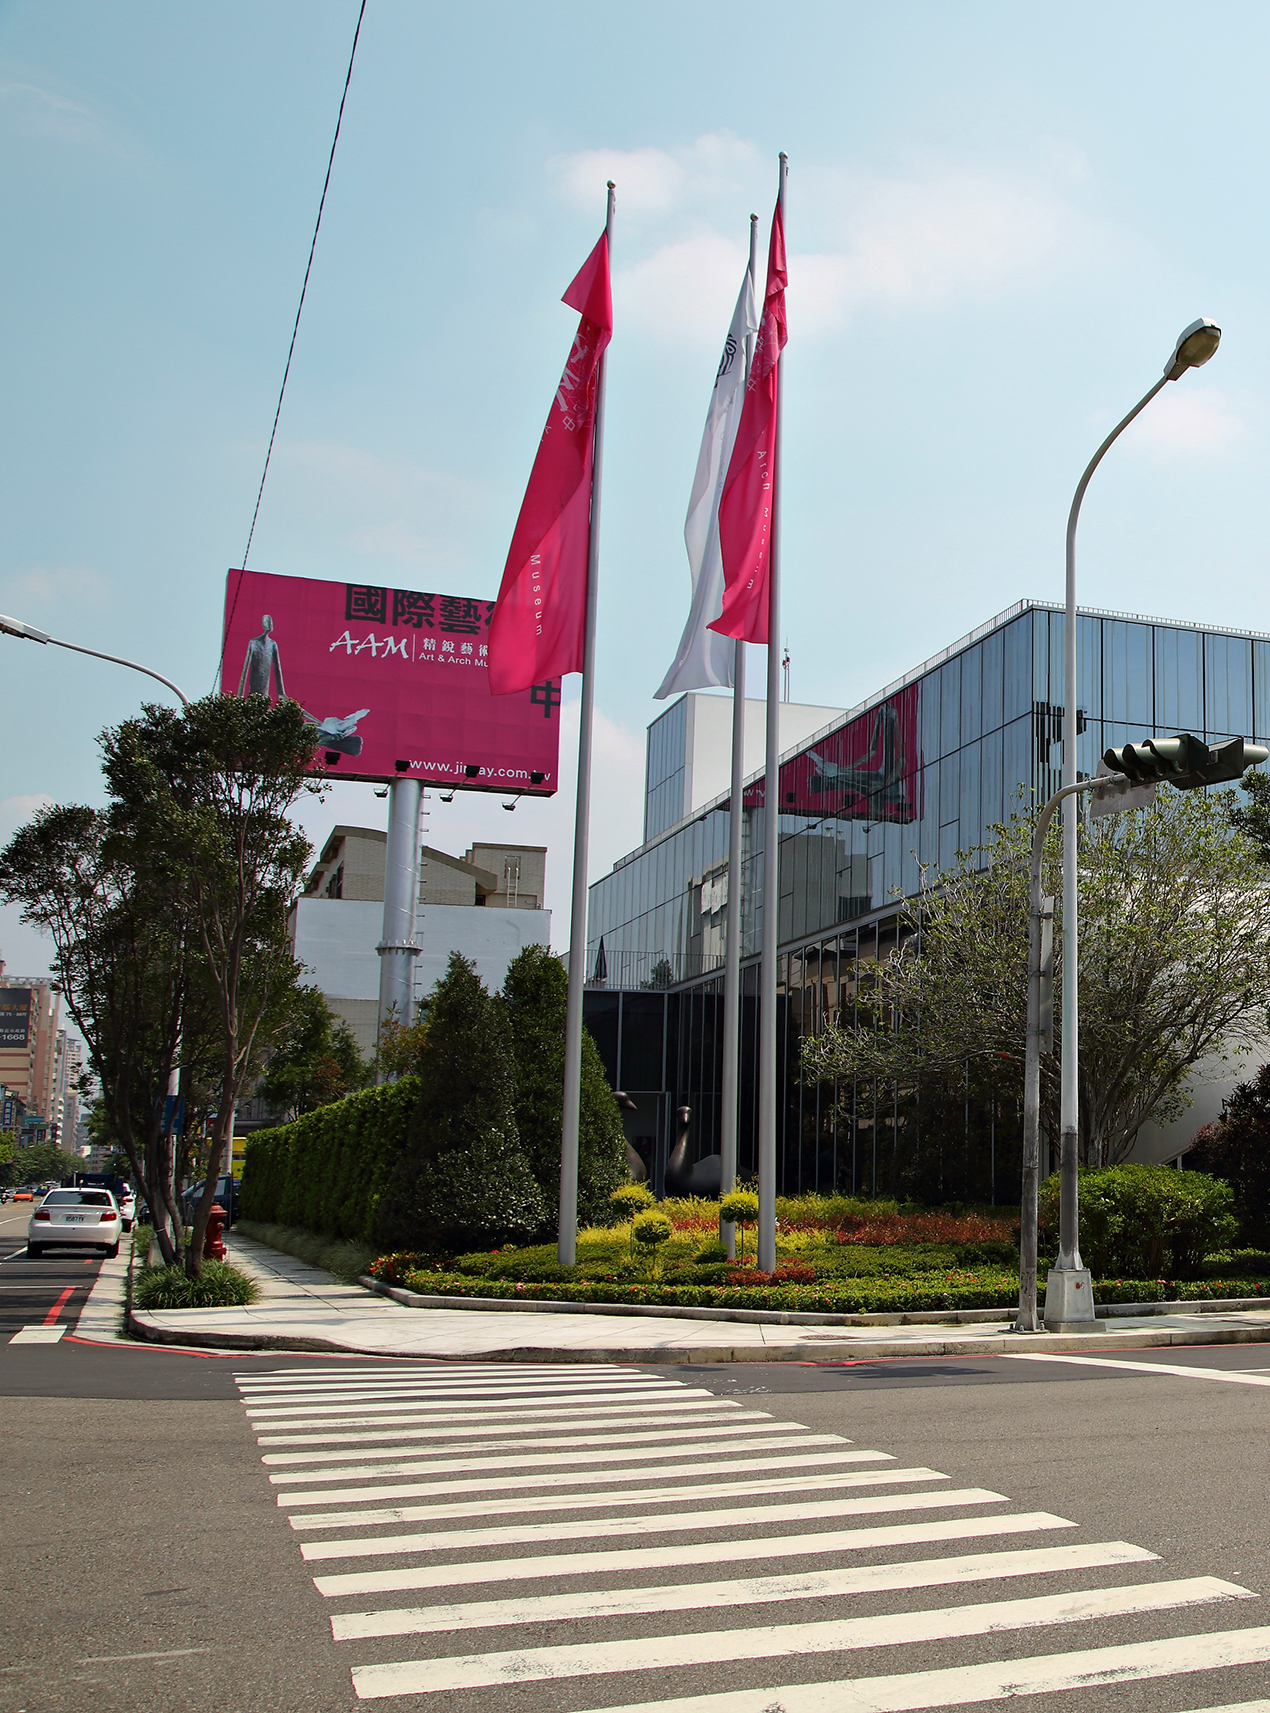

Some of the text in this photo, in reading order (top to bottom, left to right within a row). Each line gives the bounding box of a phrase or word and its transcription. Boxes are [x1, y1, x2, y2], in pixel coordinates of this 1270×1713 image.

[757, 450, 770, 490] Arch
[531, 554, 542, 636] Museum
[329, 630, 409, 659] AAM
[419, 652, 434, 661] Art
[448, 655, 471, 665] Arch
[531, 681, 561, 718] 中
